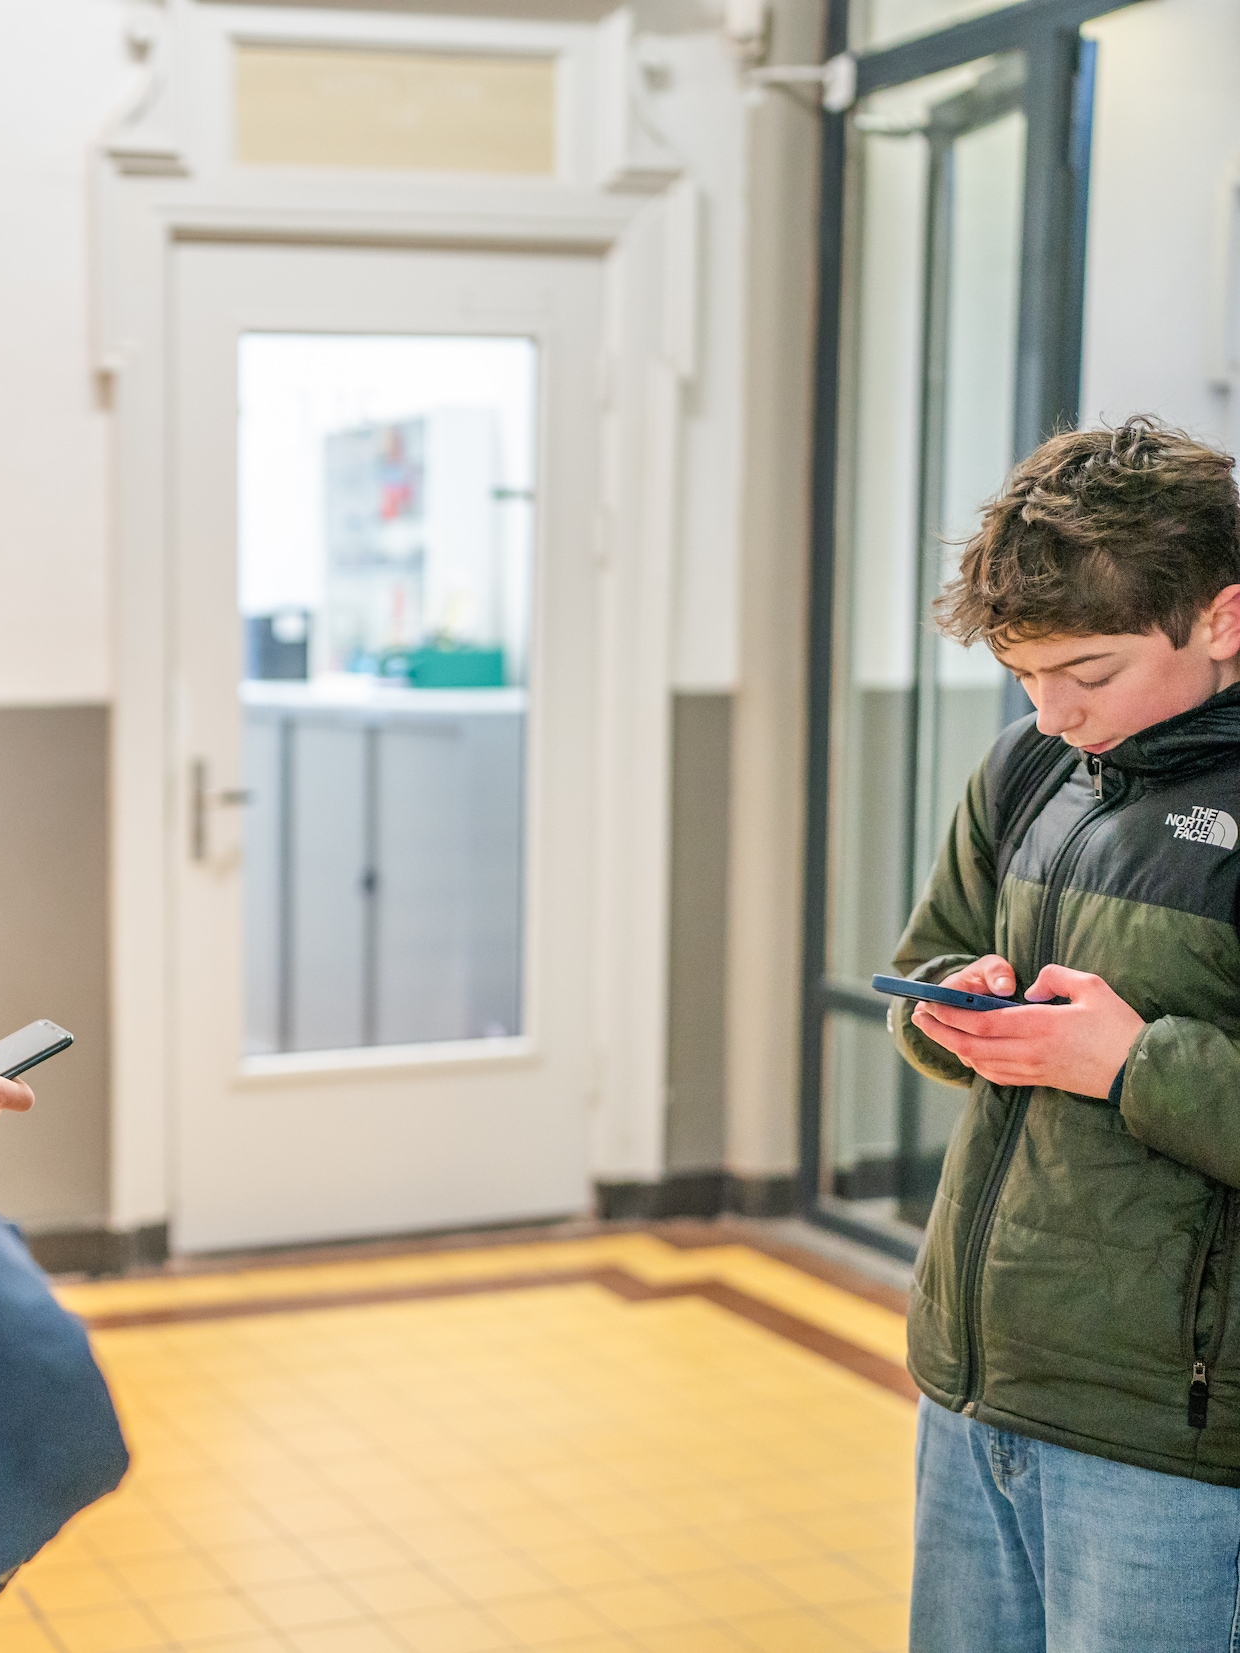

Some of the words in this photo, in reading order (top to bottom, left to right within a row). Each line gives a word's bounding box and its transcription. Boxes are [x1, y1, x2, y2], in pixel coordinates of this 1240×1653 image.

[1192, 806, 1218, 820] THE
[1165, 813, 1213, 831] NORTH
[1173, 827, 1209, 843] FACE
